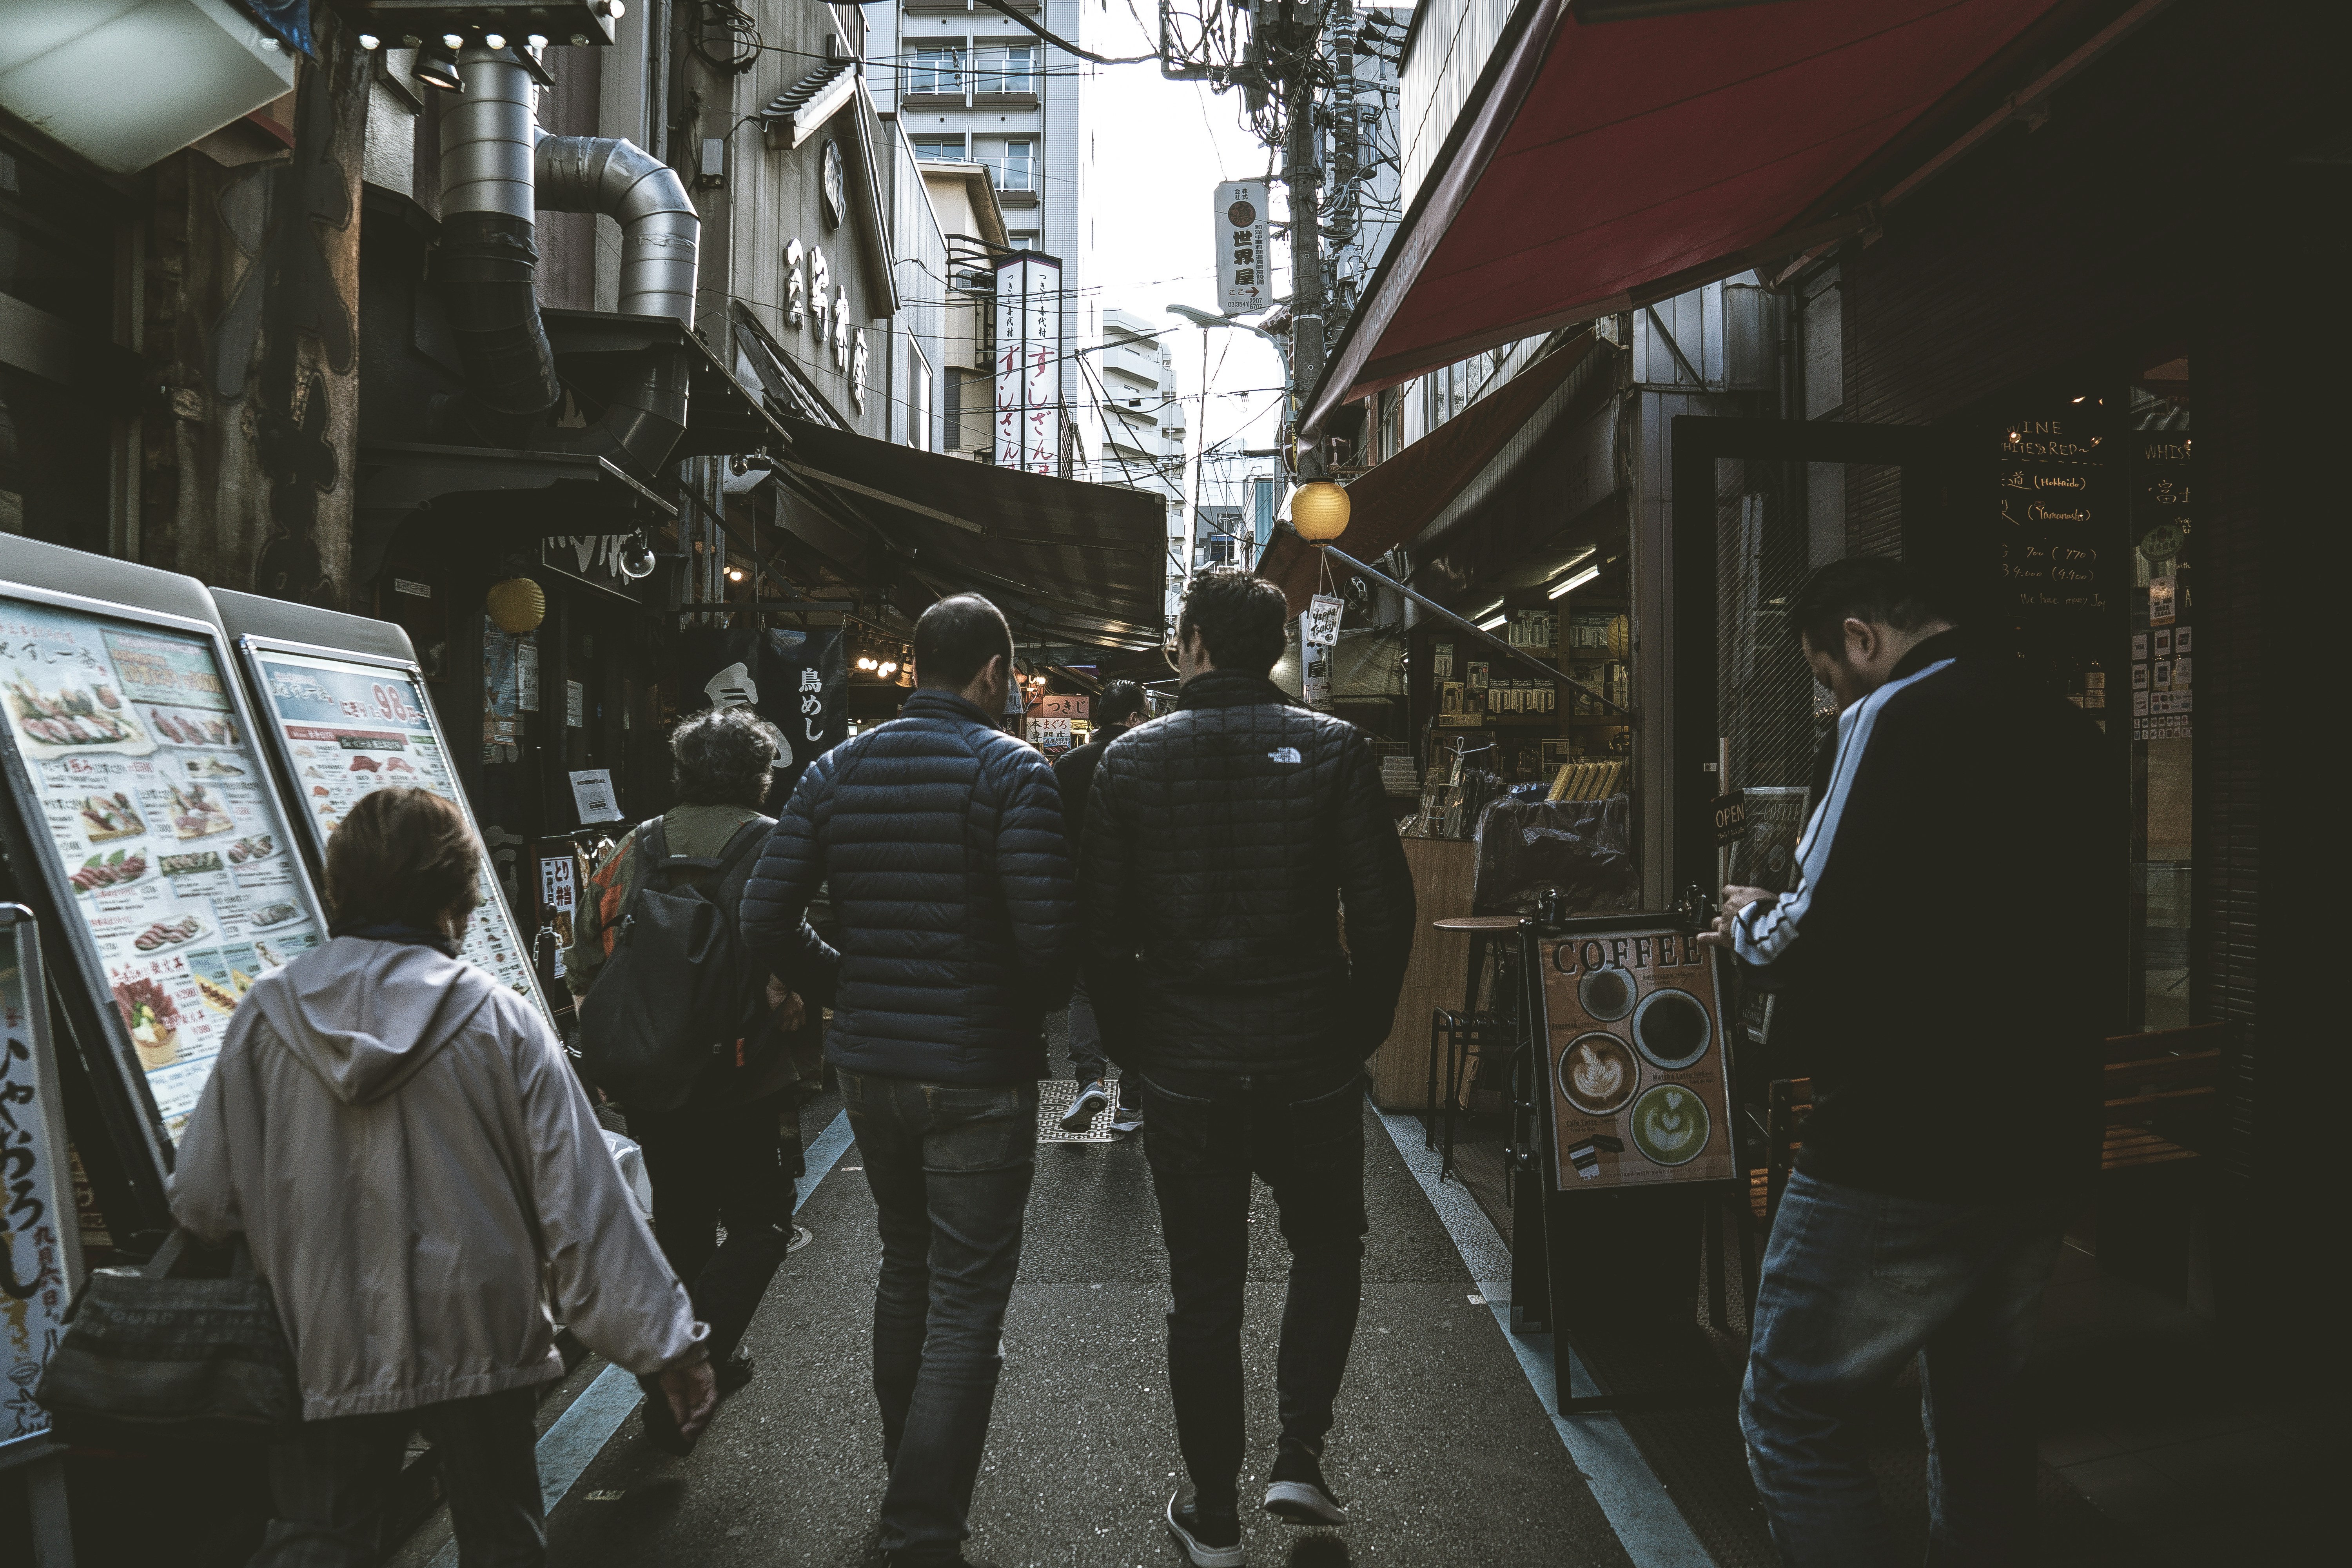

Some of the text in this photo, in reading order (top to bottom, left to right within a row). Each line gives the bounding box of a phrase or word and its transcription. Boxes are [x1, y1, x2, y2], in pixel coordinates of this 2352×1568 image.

[1234, 189, 1241, 200] 会社
[1242, 188, 1248, 200] 株式
[1232, 230, 1255, 285] 世界屋
[2034, 475, 2086, 490] (Hokkaido)
[2040, 592, 2060, 605] have
[1312, 606, 1340, 623] Yappa!
[1310, 619, 1337, 637] Tsukiji
[799, 667, 824, 742] 鳥めし
[1047, 699, 1086, 714] つきじ
[1030, 718, 1067, 730] 本まぐろ
[1715, 802, 1745, 828] OPEN
[1552, 934, 1704, 975] COFFEE
